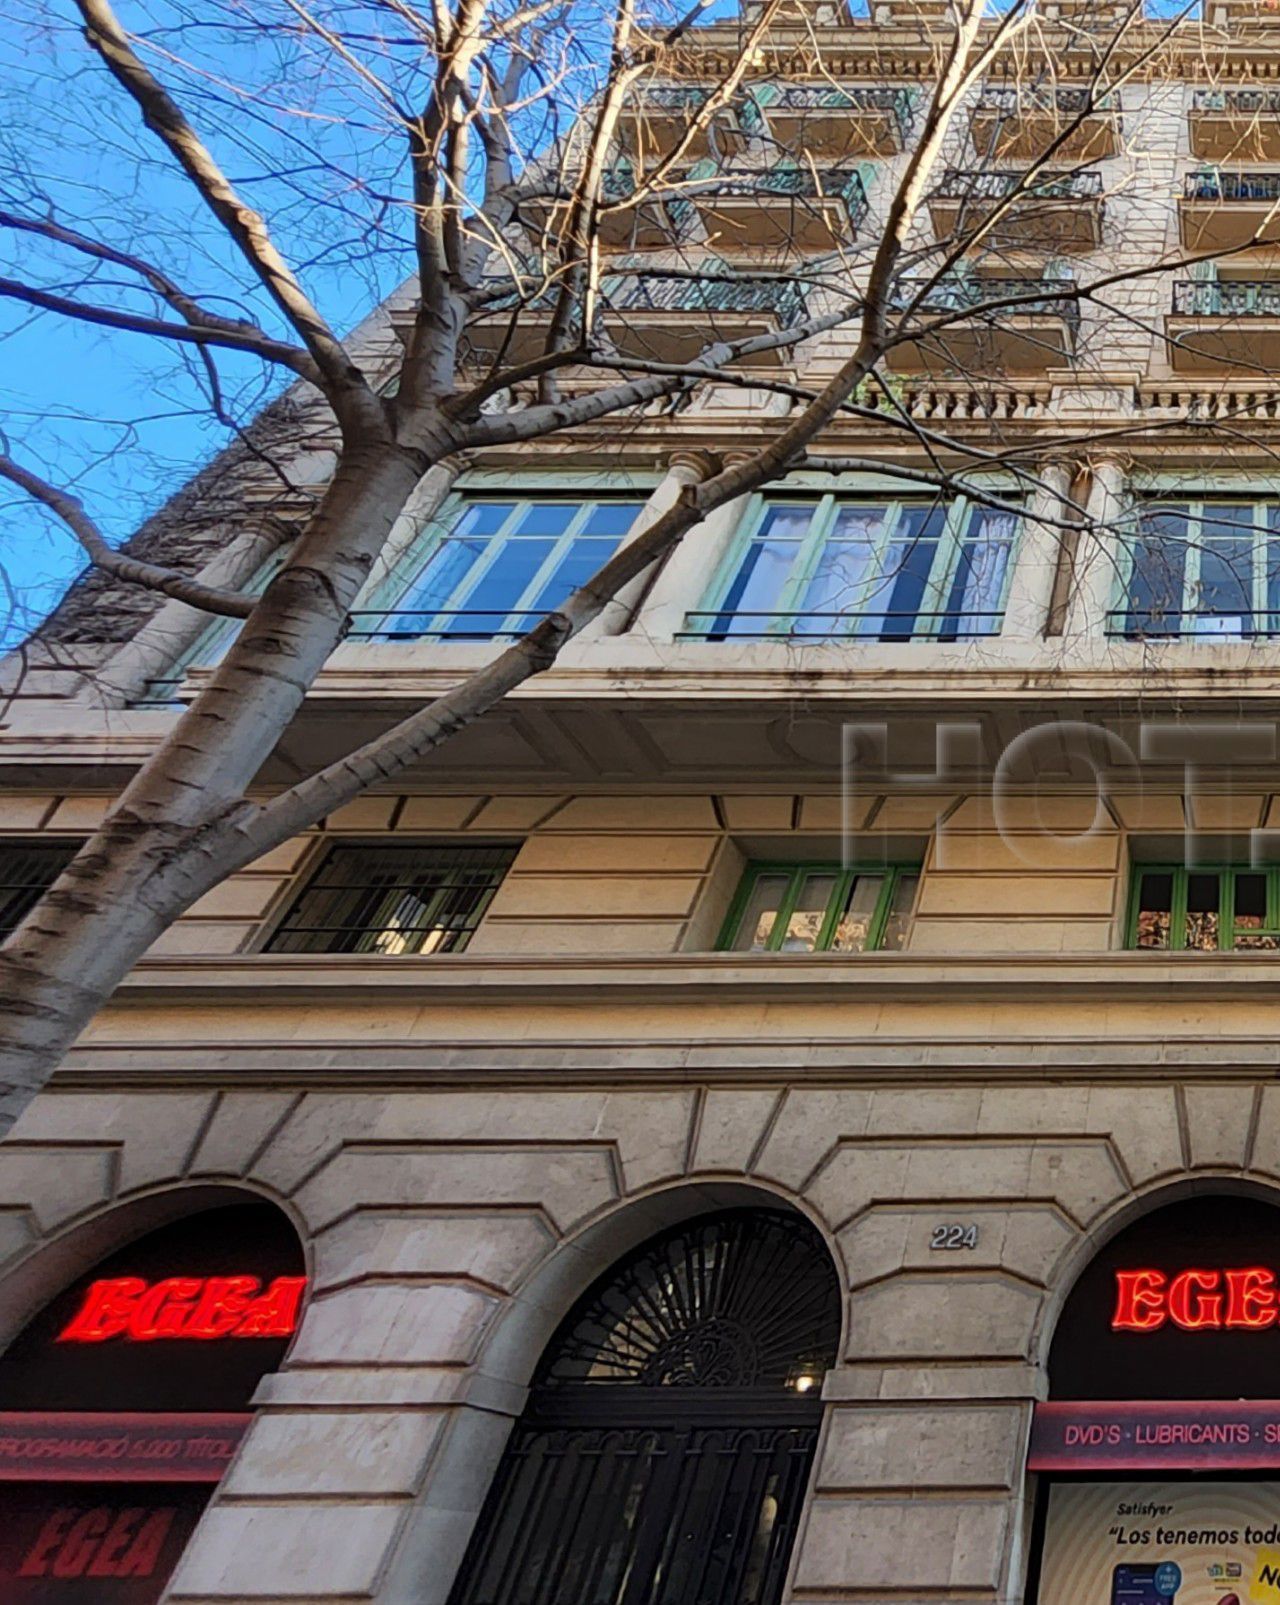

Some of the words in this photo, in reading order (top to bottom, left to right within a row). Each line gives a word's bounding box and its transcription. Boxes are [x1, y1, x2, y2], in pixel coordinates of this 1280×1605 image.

[930, 1225, 978, 1250] 224
[56, 1275, 309, 1343] EGEA
[1065, 1425, 1121, 1445] DVD'S
[1135, 1424, 1250, 1444] LUBRICANTS
[1117, 1502, 1173, 1518] Satisfyer
[14, 1507, 178, 1576] EGEA
[1156, 1527, 1239, 1544] tenemos
